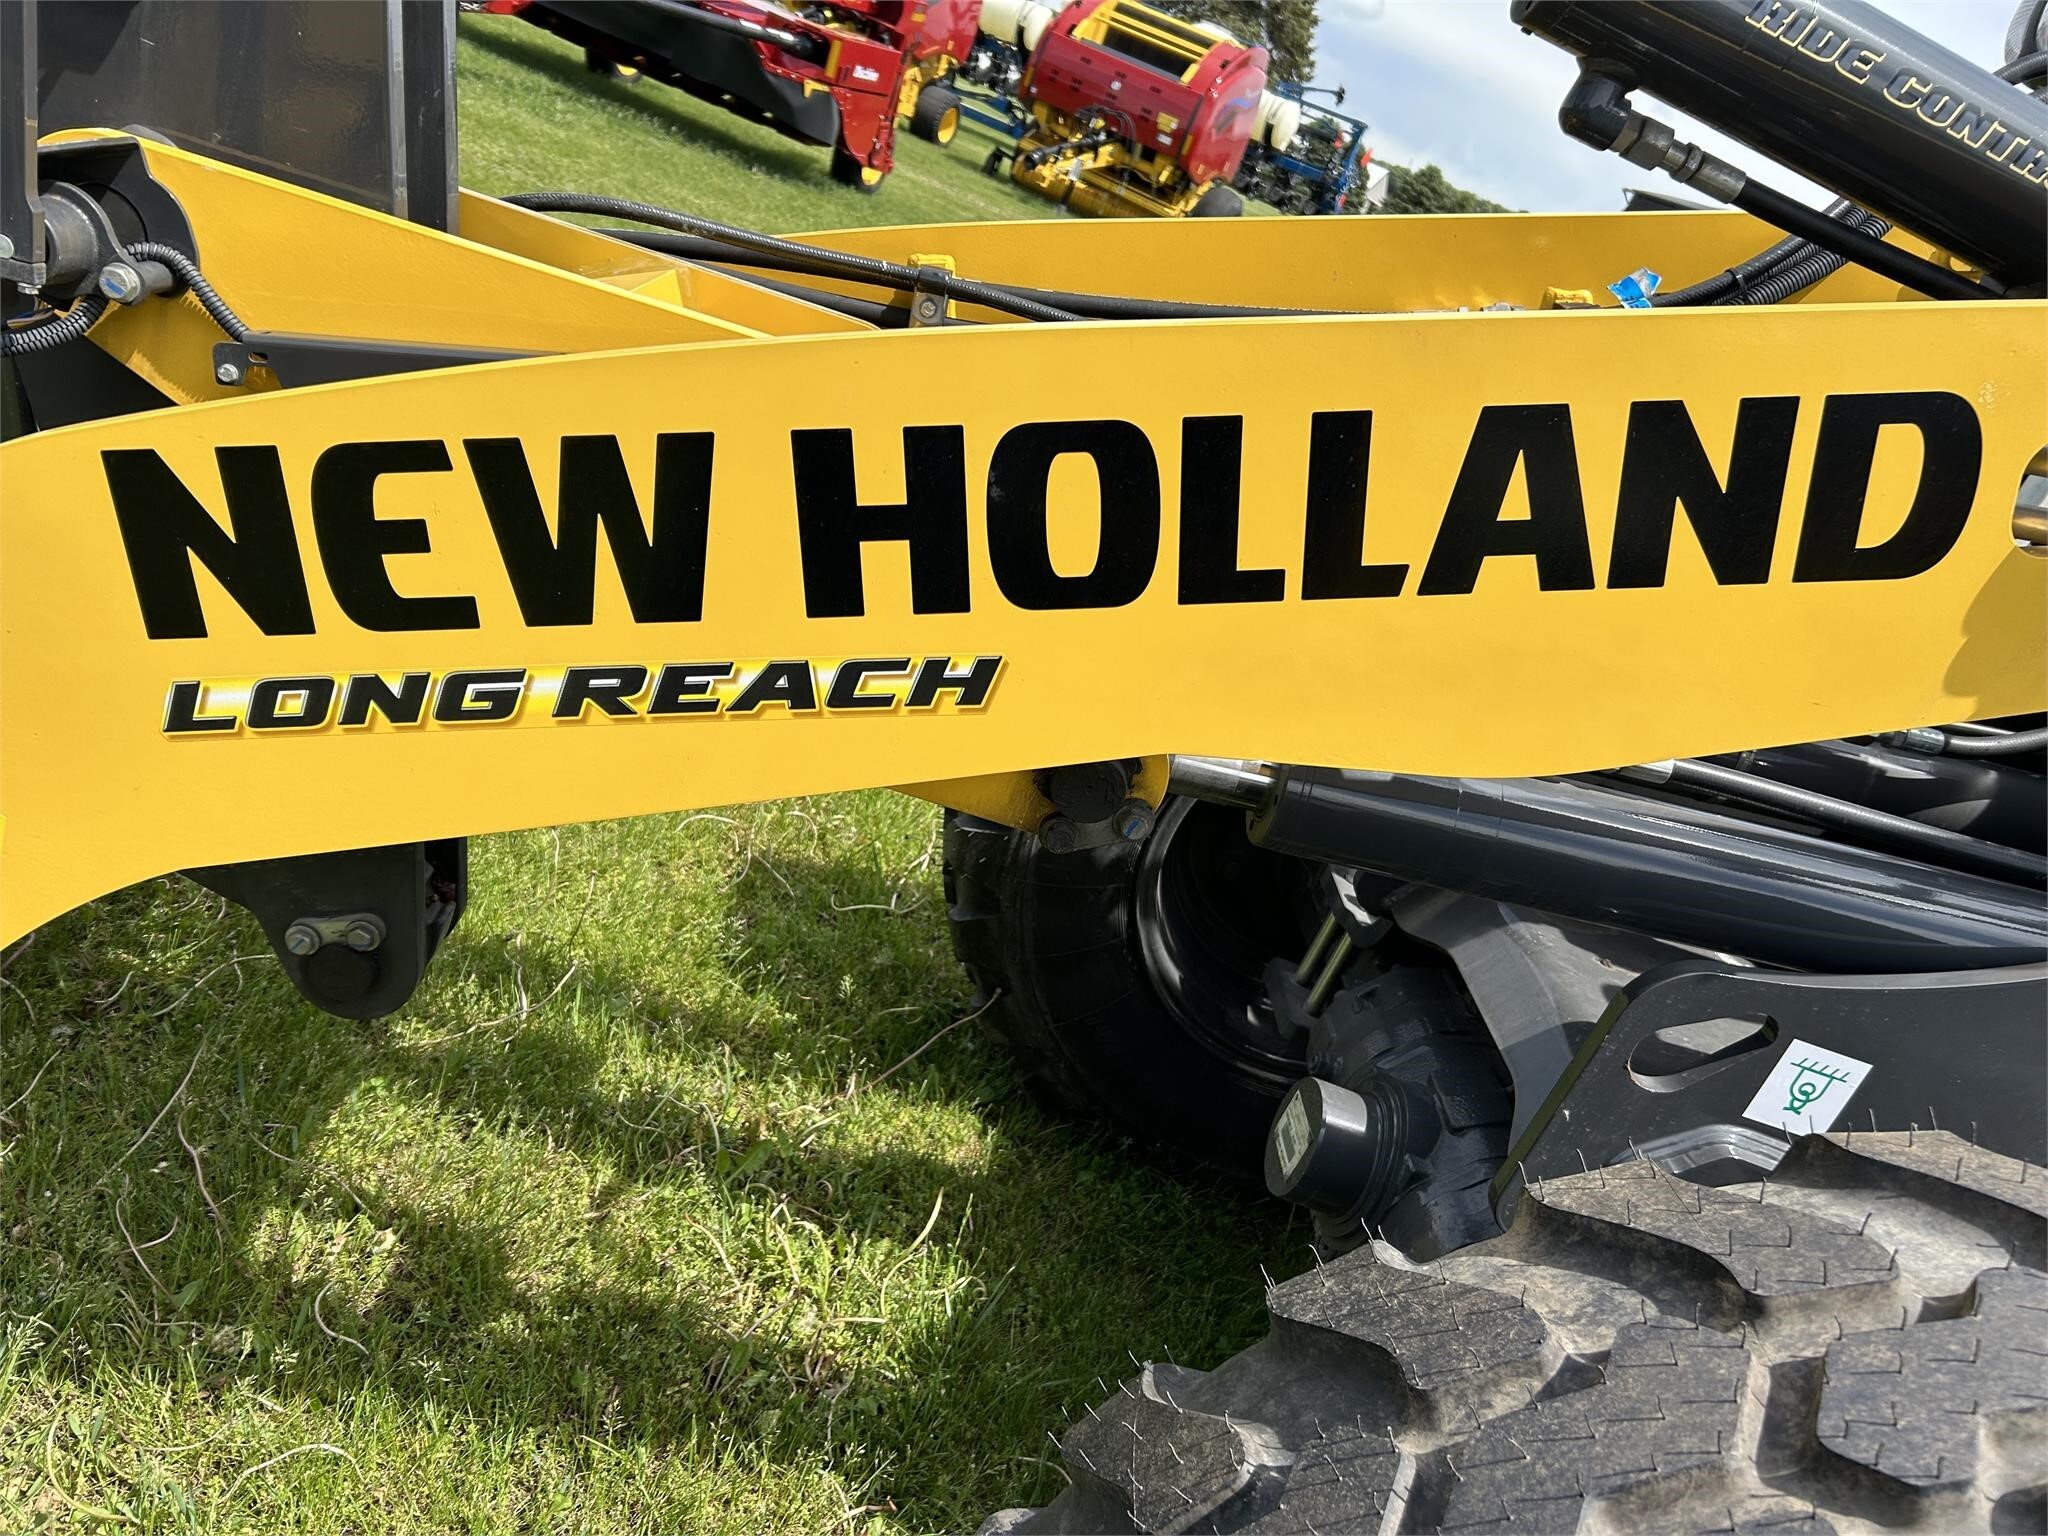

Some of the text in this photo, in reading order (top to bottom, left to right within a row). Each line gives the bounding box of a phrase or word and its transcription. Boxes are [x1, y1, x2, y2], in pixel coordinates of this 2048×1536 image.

[1744, 0, 2048, 191] RIDE CONTR
[101, 390, 1983, 640] NEW HOLLAND
[162, 655, 1005, 735] LONG REACH
